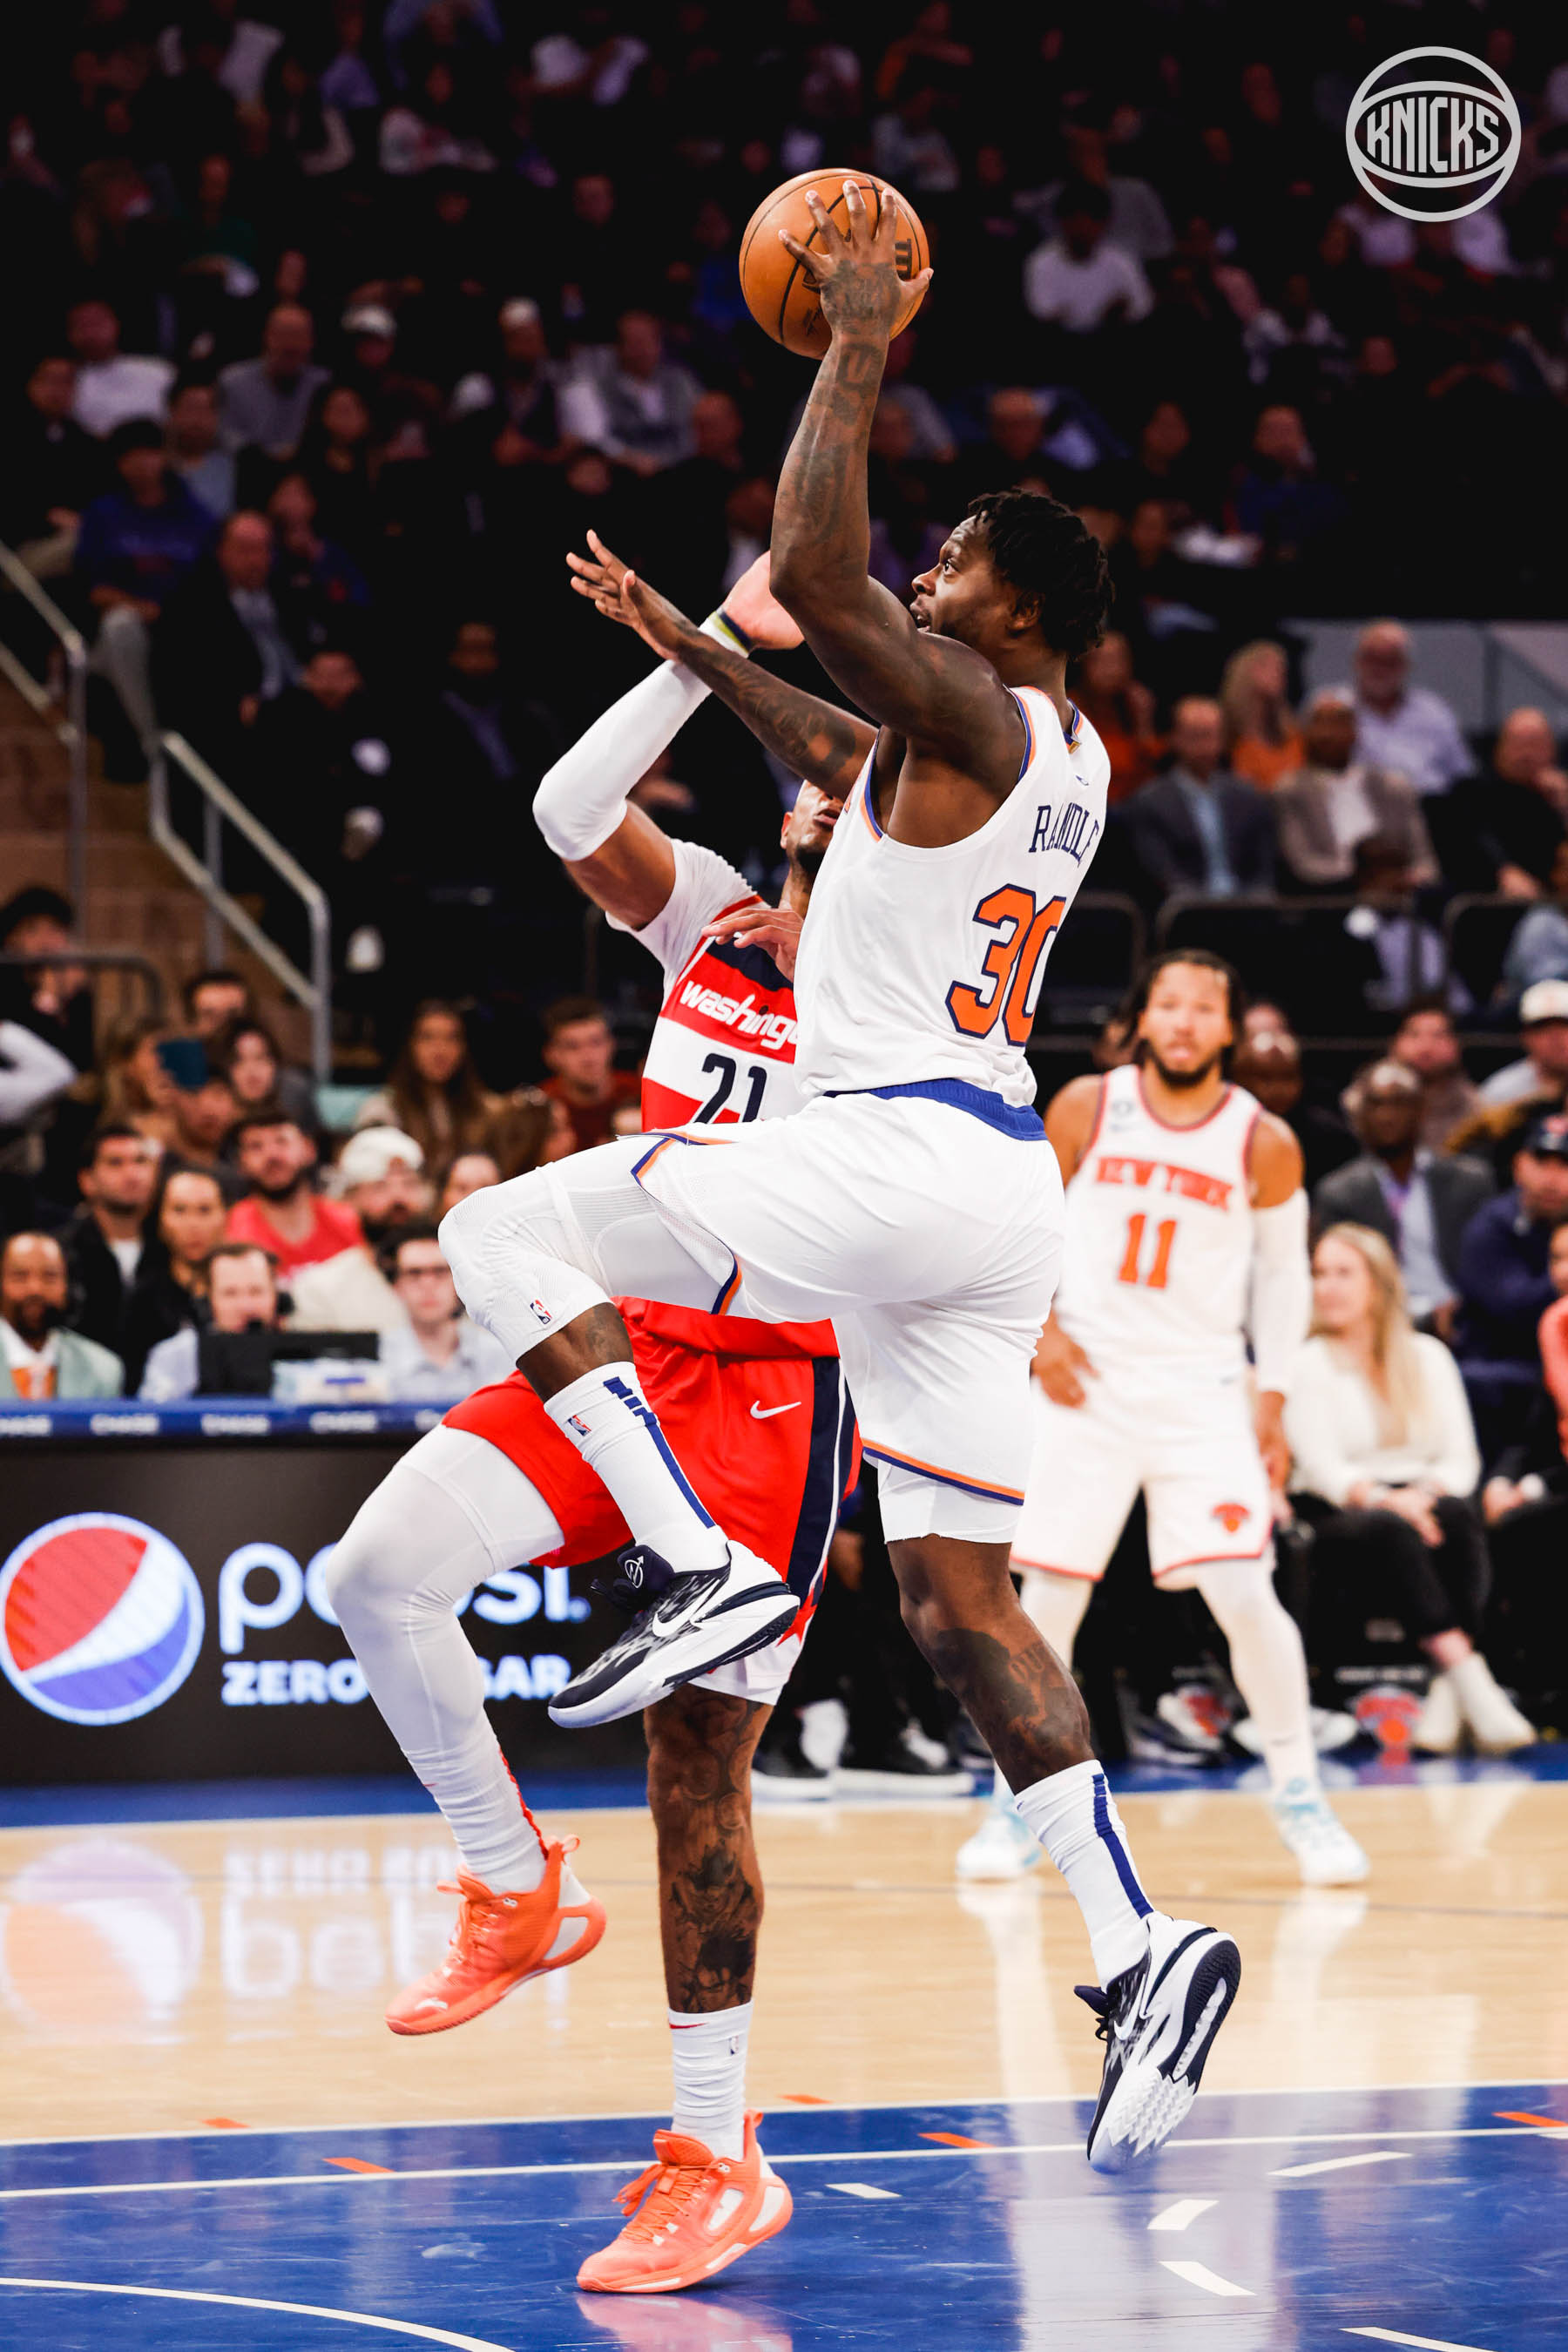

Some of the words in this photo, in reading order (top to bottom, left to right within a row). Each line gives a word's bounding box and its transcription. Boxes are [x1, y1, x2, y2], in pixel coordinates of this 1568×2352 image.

[945, 883, 1067, 1047] 30
[693, 1052, 767, 1125] 21
[1095, 1156, 1157, 1187] NEW
[1163, 1163, 1234, 1213] YORK
[1117, 1212, 1178, 1290] 11
[220, 1658, 372, 1707] ZERO
